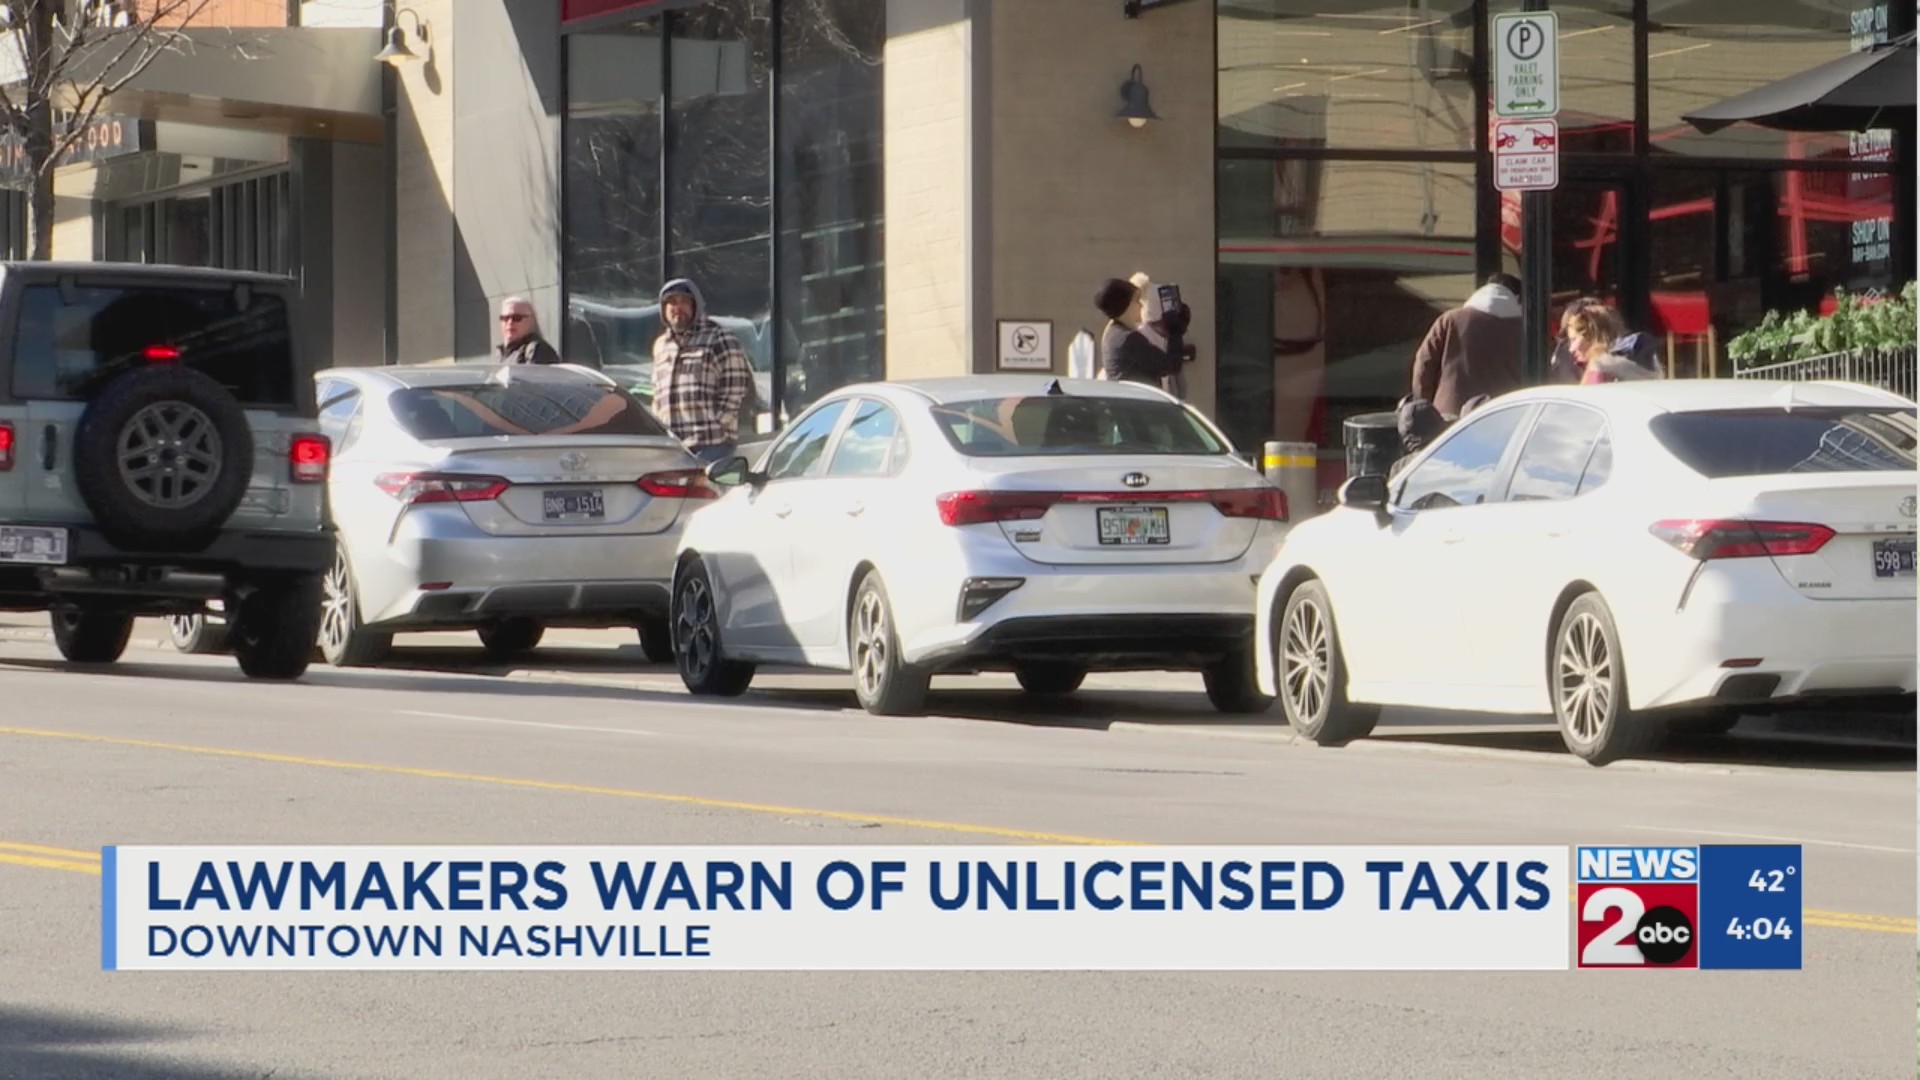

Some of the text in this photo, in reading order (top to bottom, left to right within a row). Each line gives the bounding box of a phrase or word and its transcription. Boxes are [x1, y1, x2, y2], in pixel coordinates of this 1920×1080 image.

[1851, 5, 1887, 34] SHOP ON
[1520, 27, 1530, 53] P
[1514, 63, 1537, 74] VALET
[1508, 74, 1543, 86] PARKING
[1515, 87, 1536, 97] ONLY
[1852, 217, 1889, 244] SHOP ON
[1876, 551, 1900, 570] 598
